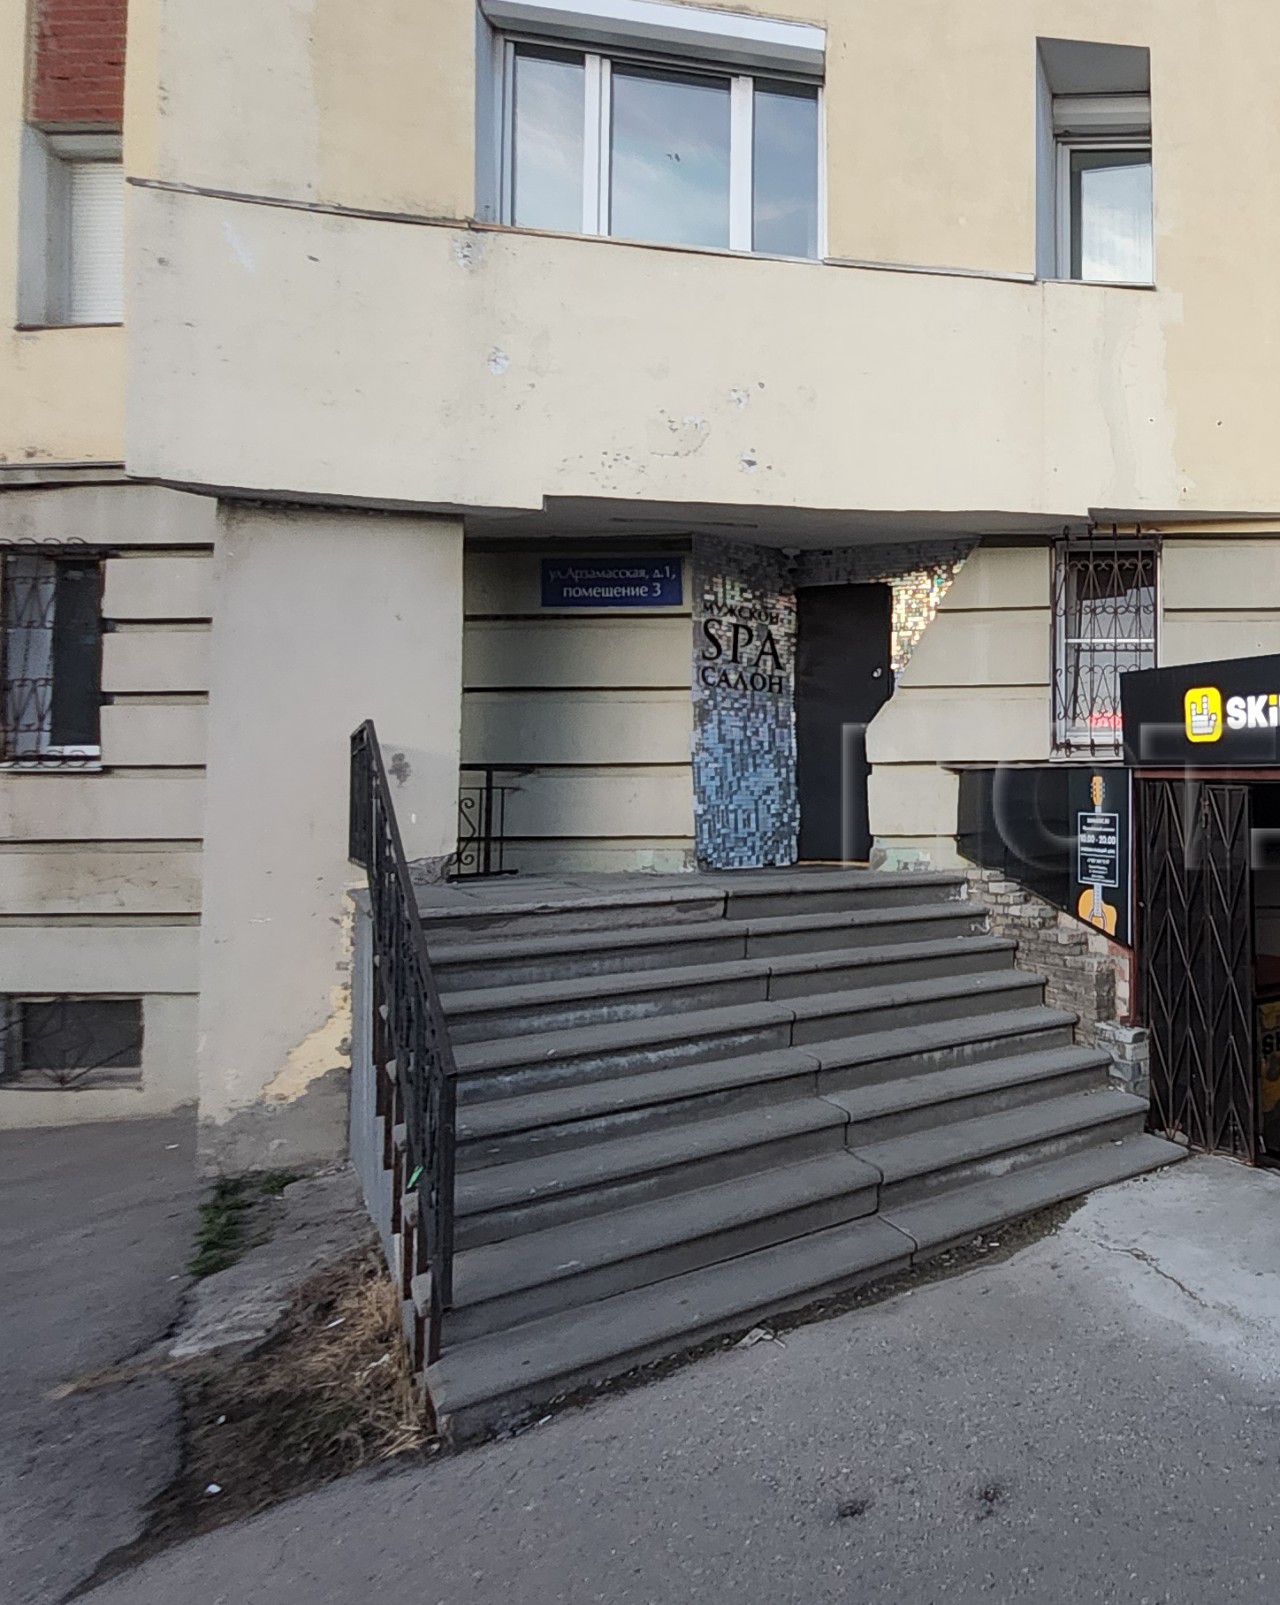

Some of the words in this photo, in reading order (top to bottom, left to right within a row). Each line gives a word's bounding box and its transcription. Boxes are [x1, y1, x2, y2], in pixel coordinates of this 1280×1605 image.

[563, 585, 649, 599] помещение
[652, 583, 662, 597] 3
[702, 618, 783, 670] SPA
[702, 666, 784, 695] САЛОН
